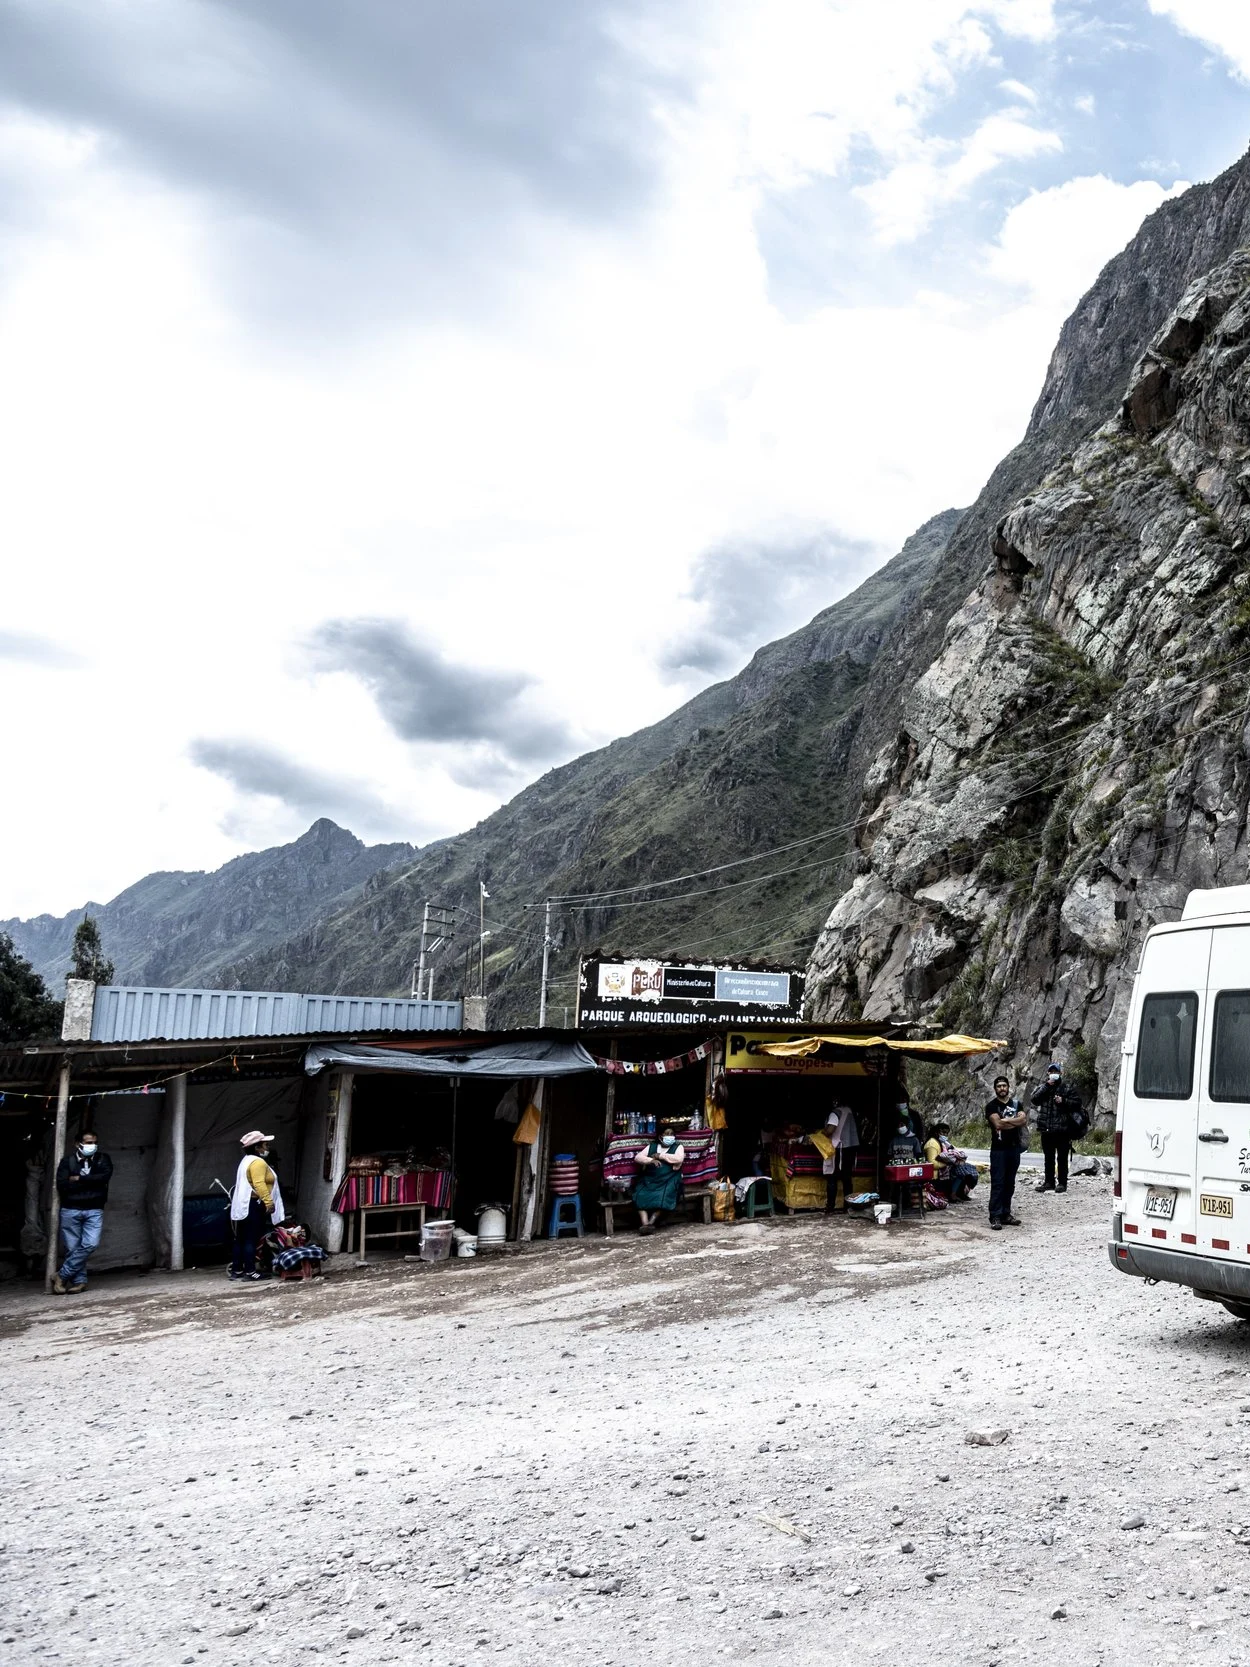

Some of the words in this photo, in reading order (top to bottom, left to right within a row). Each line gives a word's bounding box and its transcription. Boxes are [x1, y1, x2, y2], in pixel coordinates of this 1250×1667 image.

[581, 1010, 625, 1022] PARQUE
[629, 1011, 706, 1024] ARQUEOLOGICO
[784, 1057, 834, 1070] Oropesa
[1145, 1196, 1173, 1214] V1E-951
[1202, 1198, 1232, 1215] V1E-951
